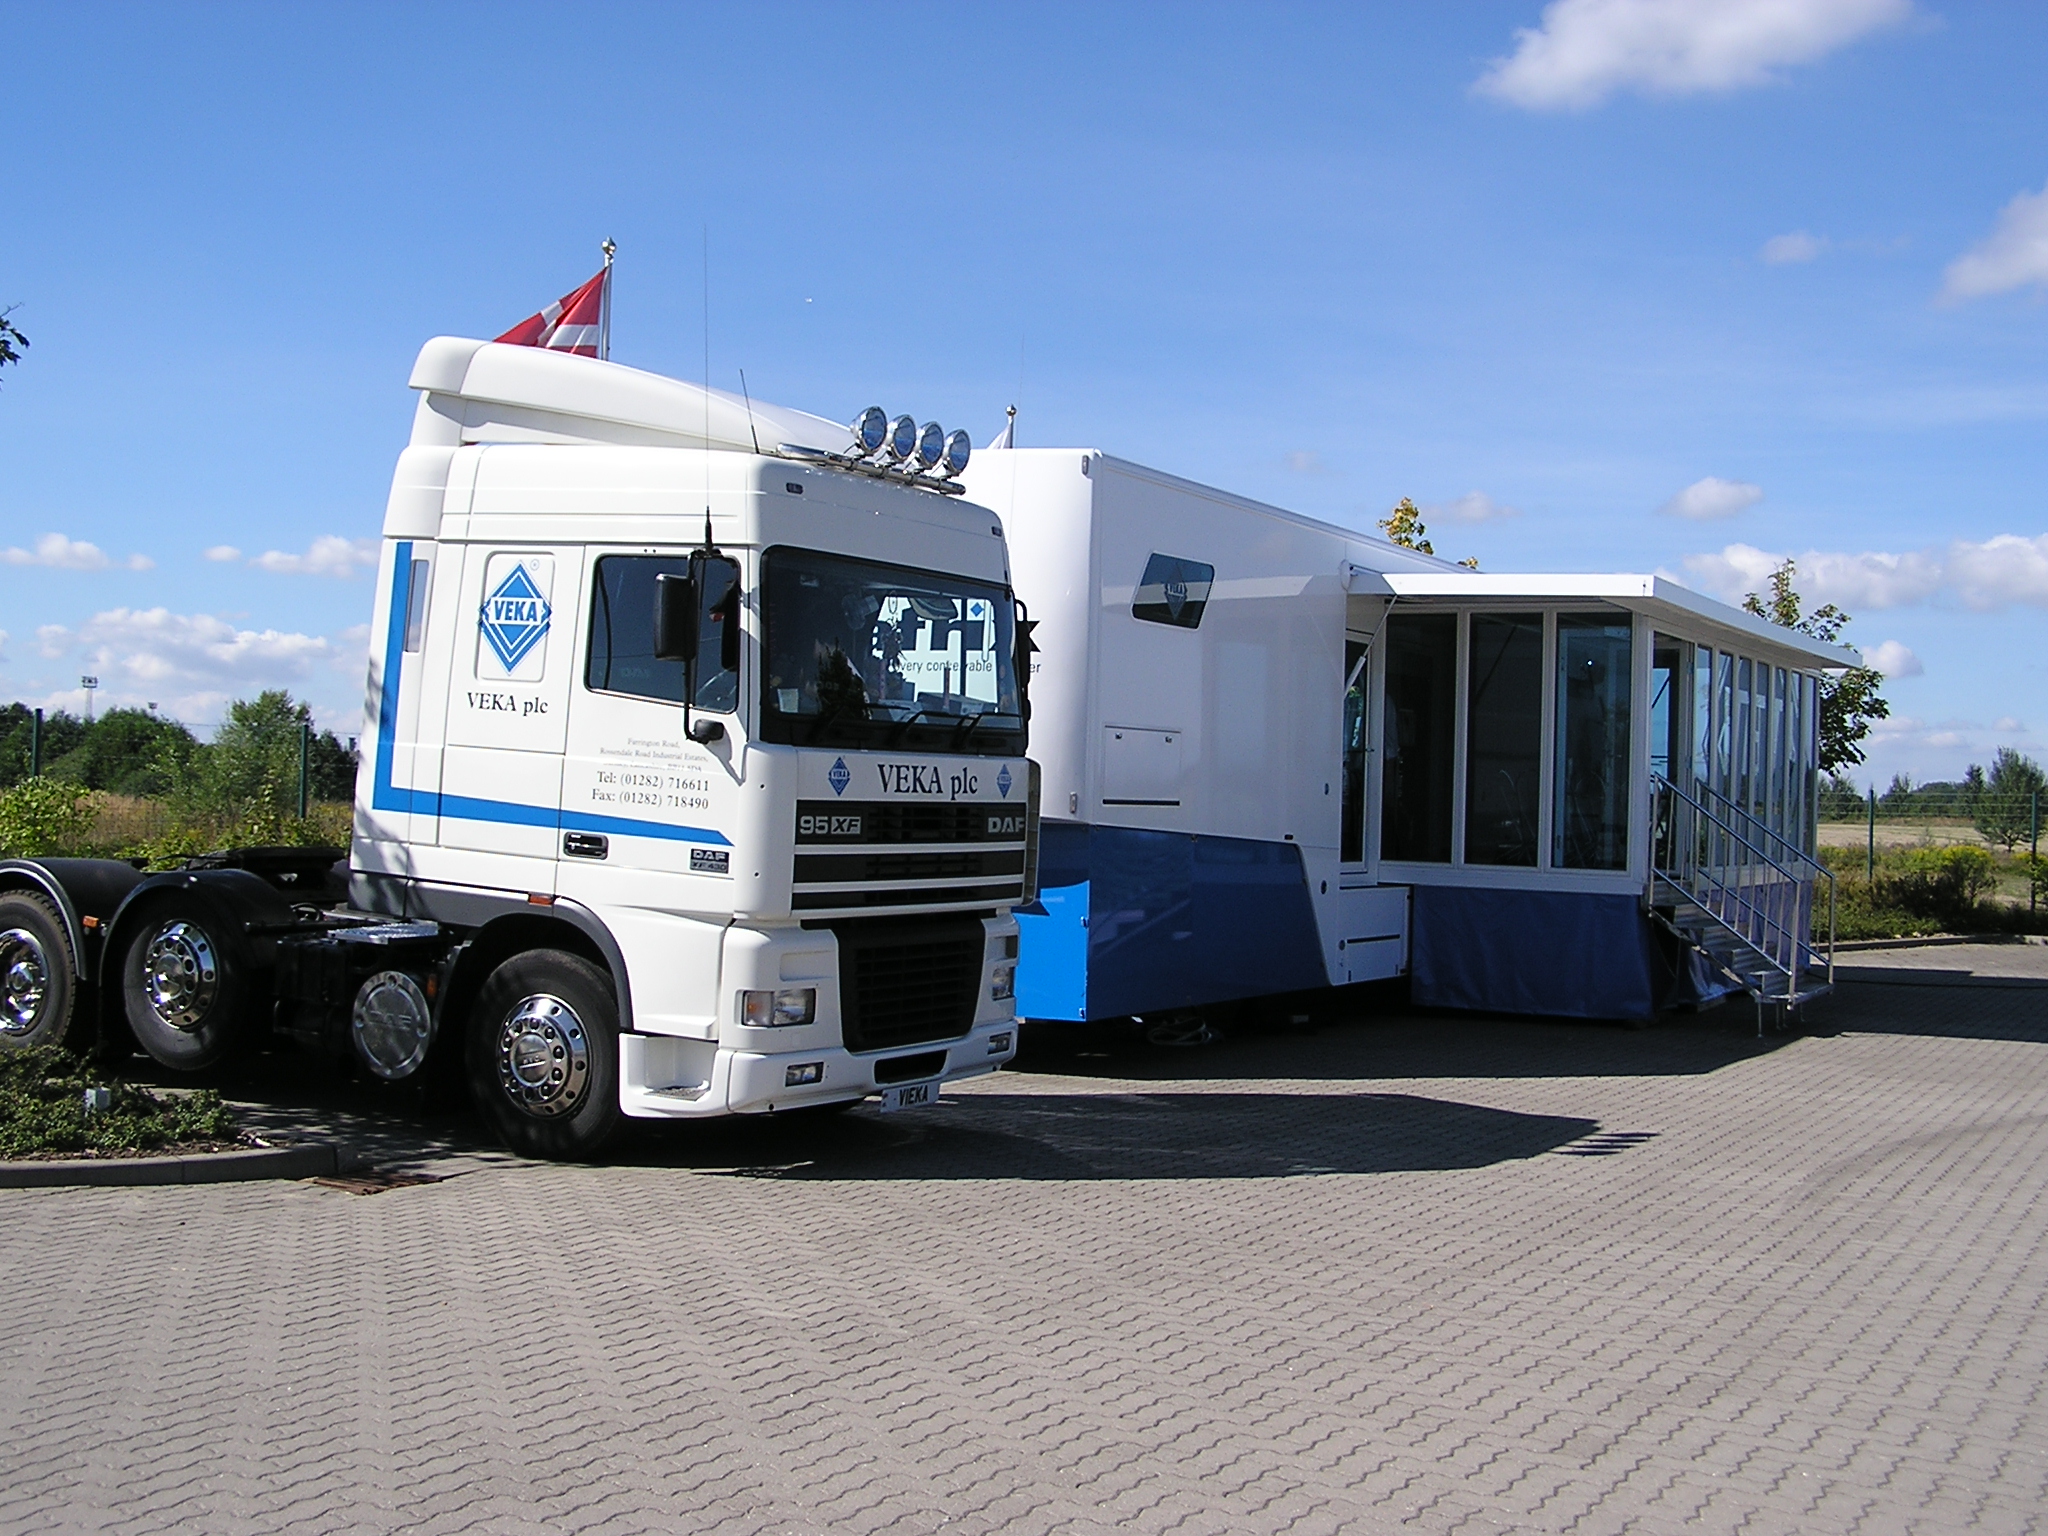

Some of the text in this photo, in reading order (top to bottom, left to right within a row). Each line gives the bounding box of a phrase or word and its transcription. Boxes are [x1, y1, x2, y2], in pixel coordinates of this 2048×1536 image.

[494, 600, 538, 622] VEKA
[467, 692, 549, 717] VEKA plc
[652, 751, 682, 760] Industrial
[597, 770, 710, 792] Tel: (01282) 716611
[877, 764, 978, 800] VEKA plc
[591, 788, 709, 810] Fax: (01282) 718490
[987, 817, 1025, 833] DAF
[693, 850, 726, 860] DAF
